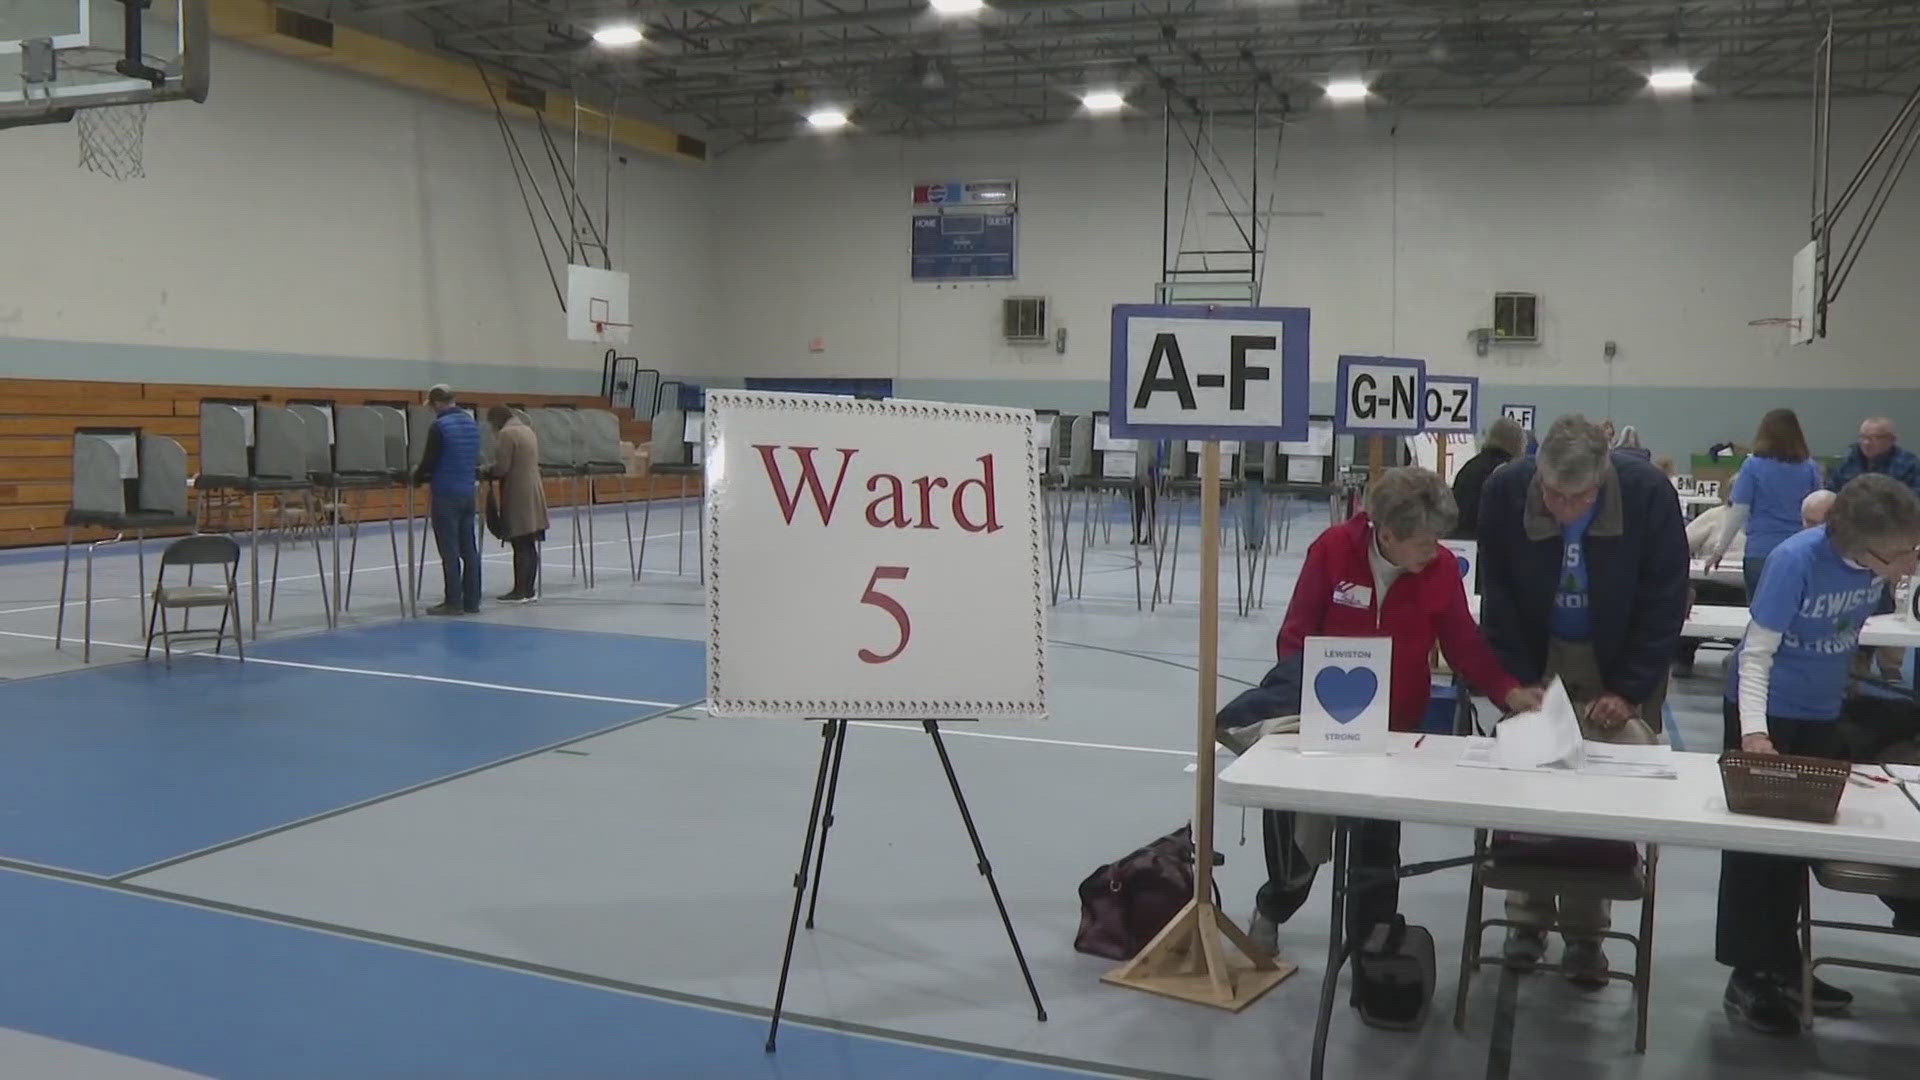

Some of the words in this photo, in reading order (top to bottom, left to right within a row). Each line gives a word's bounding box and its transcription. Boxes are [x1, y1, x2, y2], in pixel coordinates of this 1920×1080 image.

[1133, 332, 1277, 411] A-F
[1351, 373, 1415, 420] G-N
[1424, 388, 1469, 423] O-Z
[751, 444, 1004, 534] Ward
[1696, 482, 1718, 497] A-F
[857, 565, 911, 664] 5
[1324, 650, 1372, 658] LEWISTON
[1325, 733, 1361, 741] STRONG
